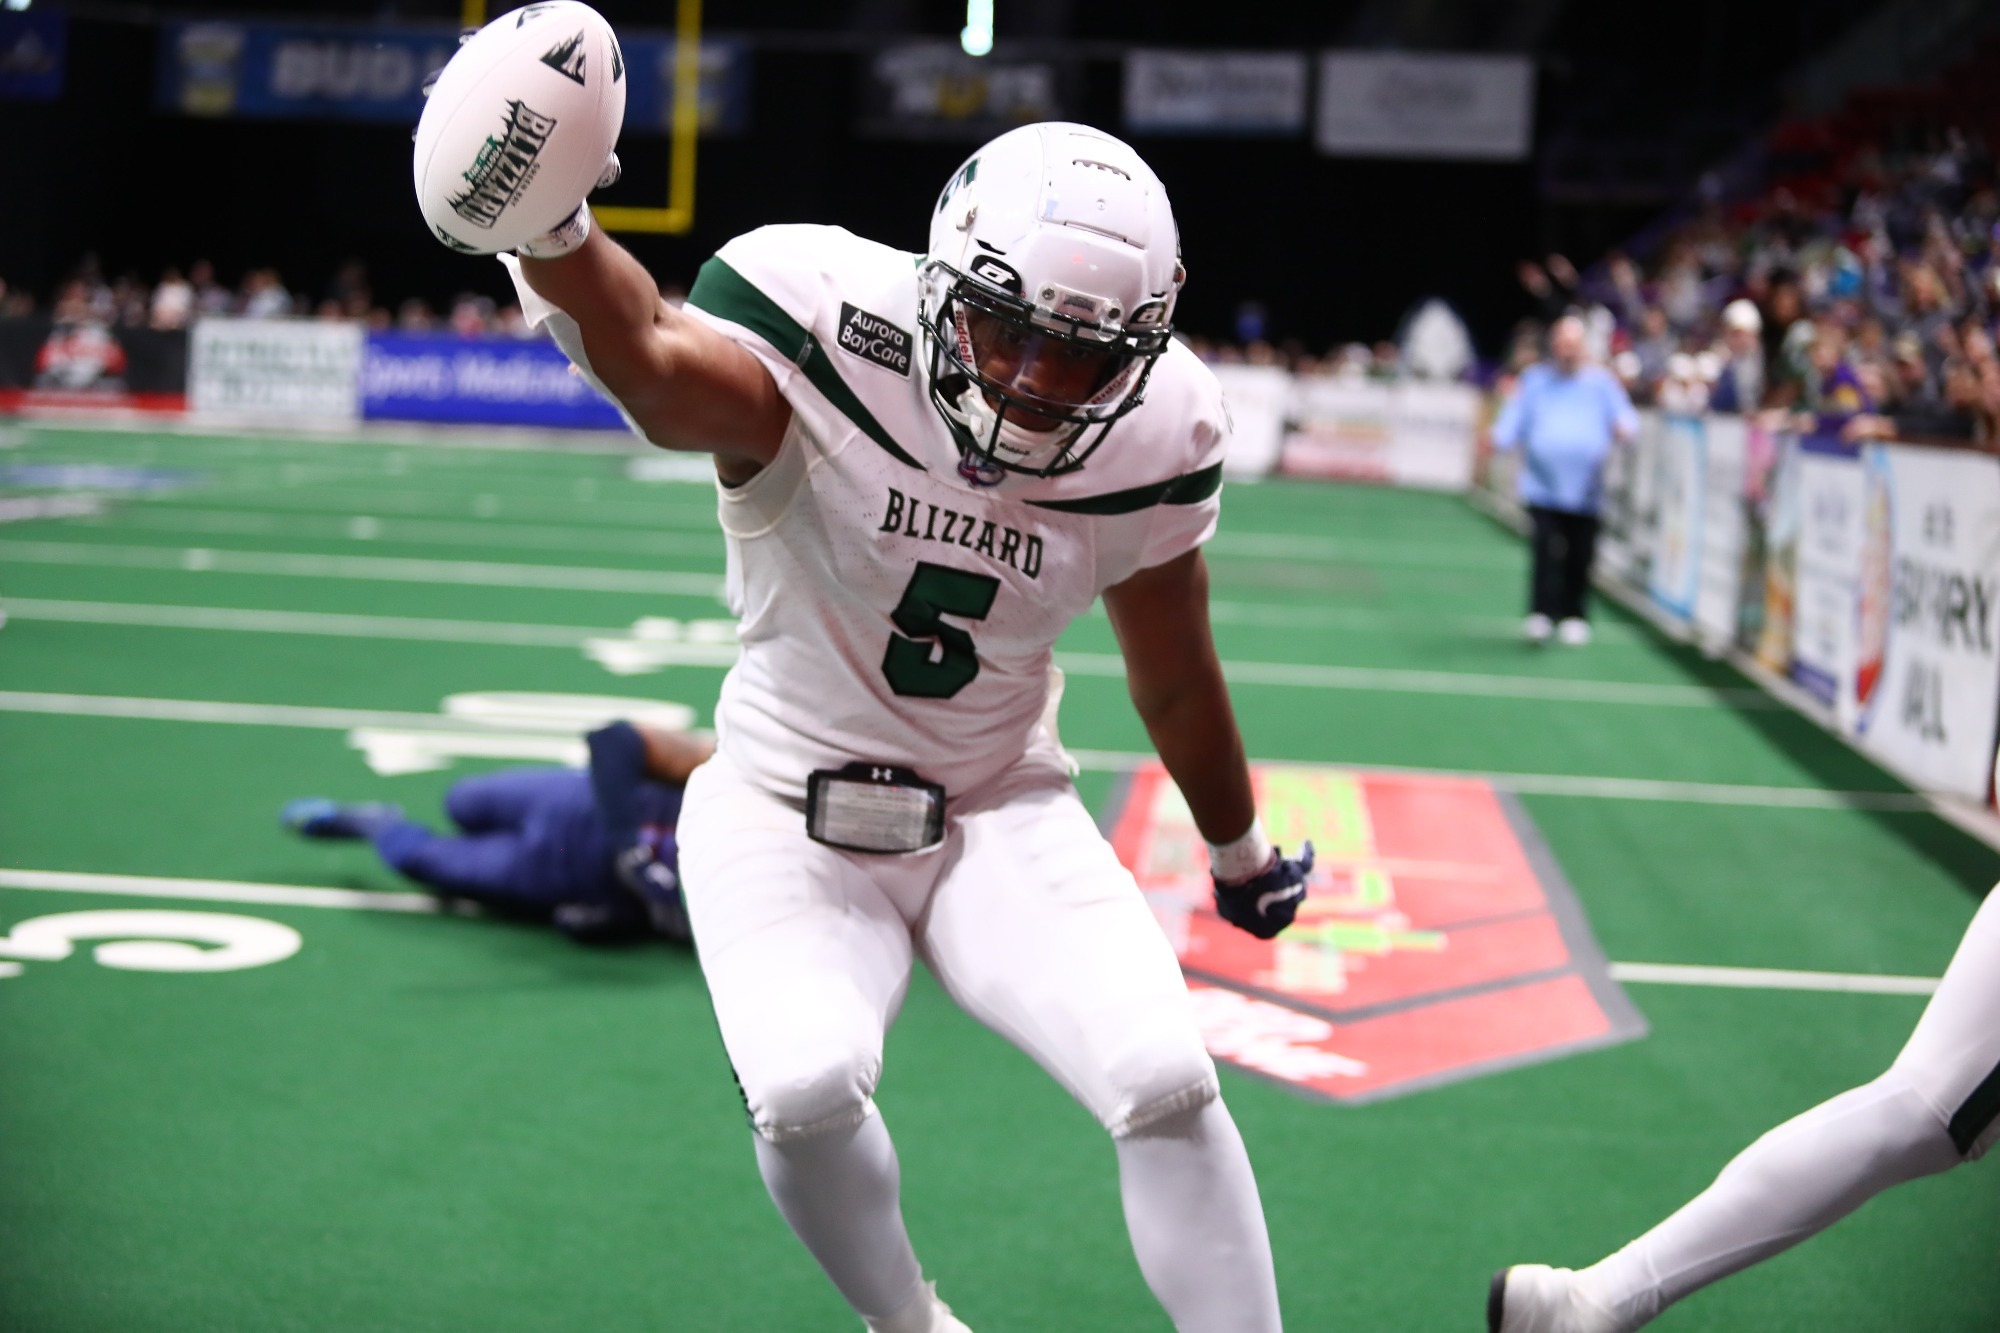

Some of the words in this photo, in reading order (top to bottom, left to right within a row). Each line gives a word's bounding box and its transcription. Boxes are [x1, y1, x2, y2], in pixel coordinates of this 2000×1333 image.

[456, 100, 557, 229] BLIZZARD
[841, 325, 907, 369] BayCare
[850, 310, 905, 347] Aurora
[955, 310, 973, 365] Riddell
[879, 487, 1043, 580] BLIZZARD
[881, 560, 1001, 699] 5
